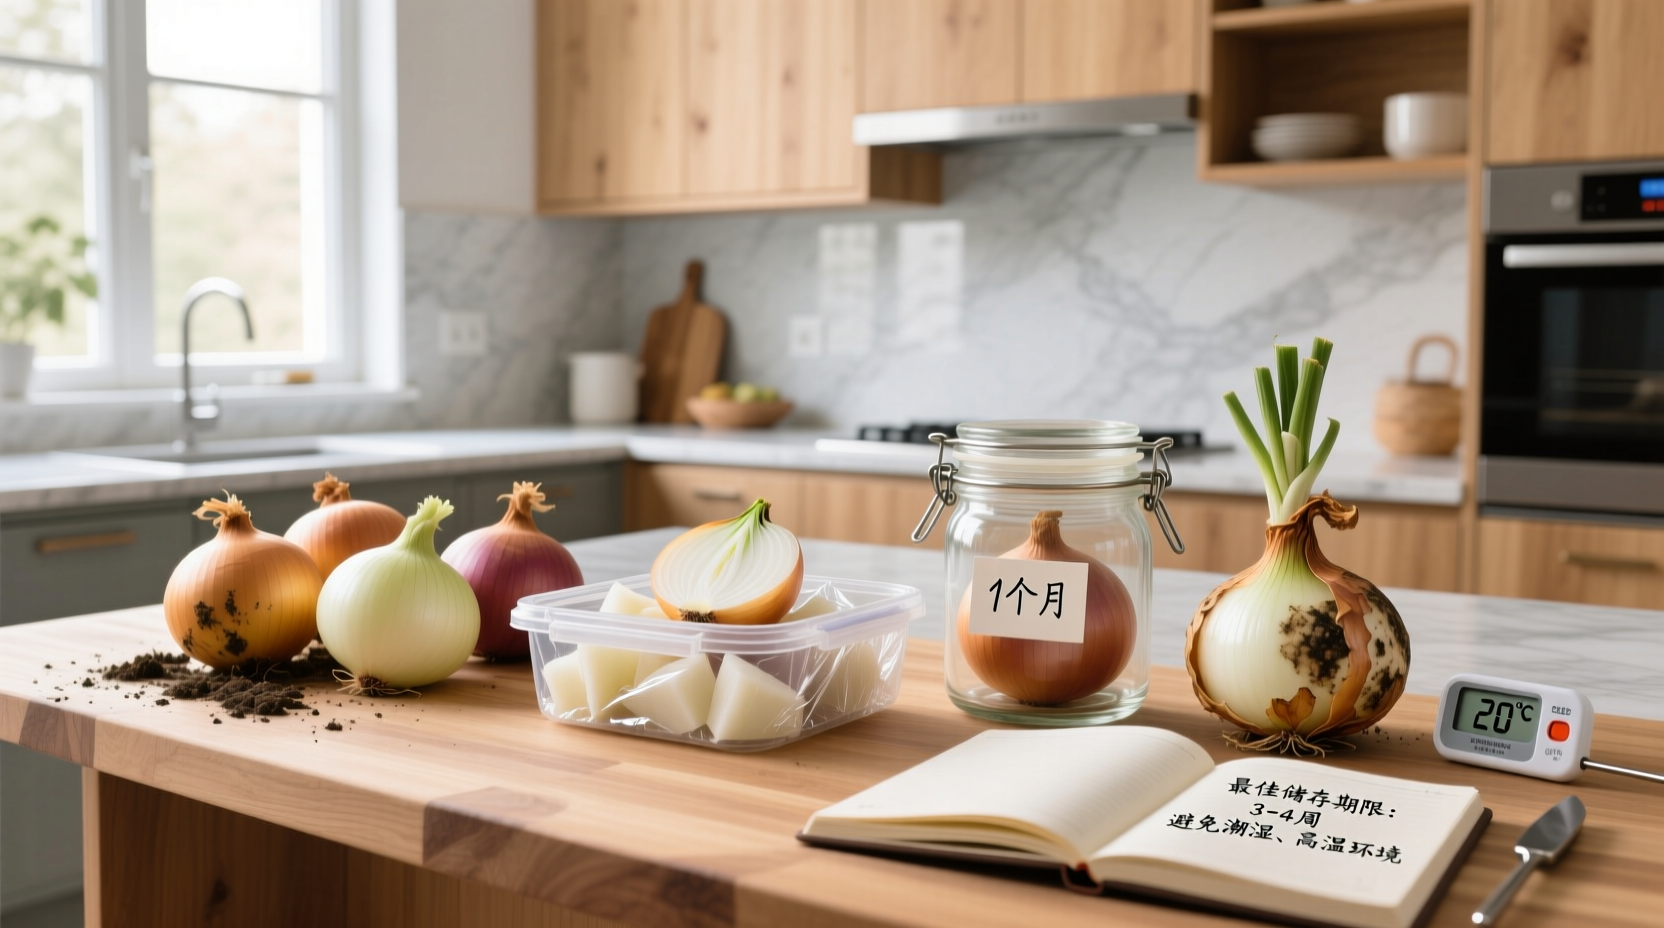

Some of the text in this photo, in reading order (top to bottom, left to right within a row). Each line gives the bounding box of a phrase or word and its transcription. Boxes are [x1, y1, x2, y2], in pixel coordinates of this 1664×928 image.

[989, 577, 1064, 619] 1个月
[1166, 813, 1402, 864] 避免潮湿、高温环境
